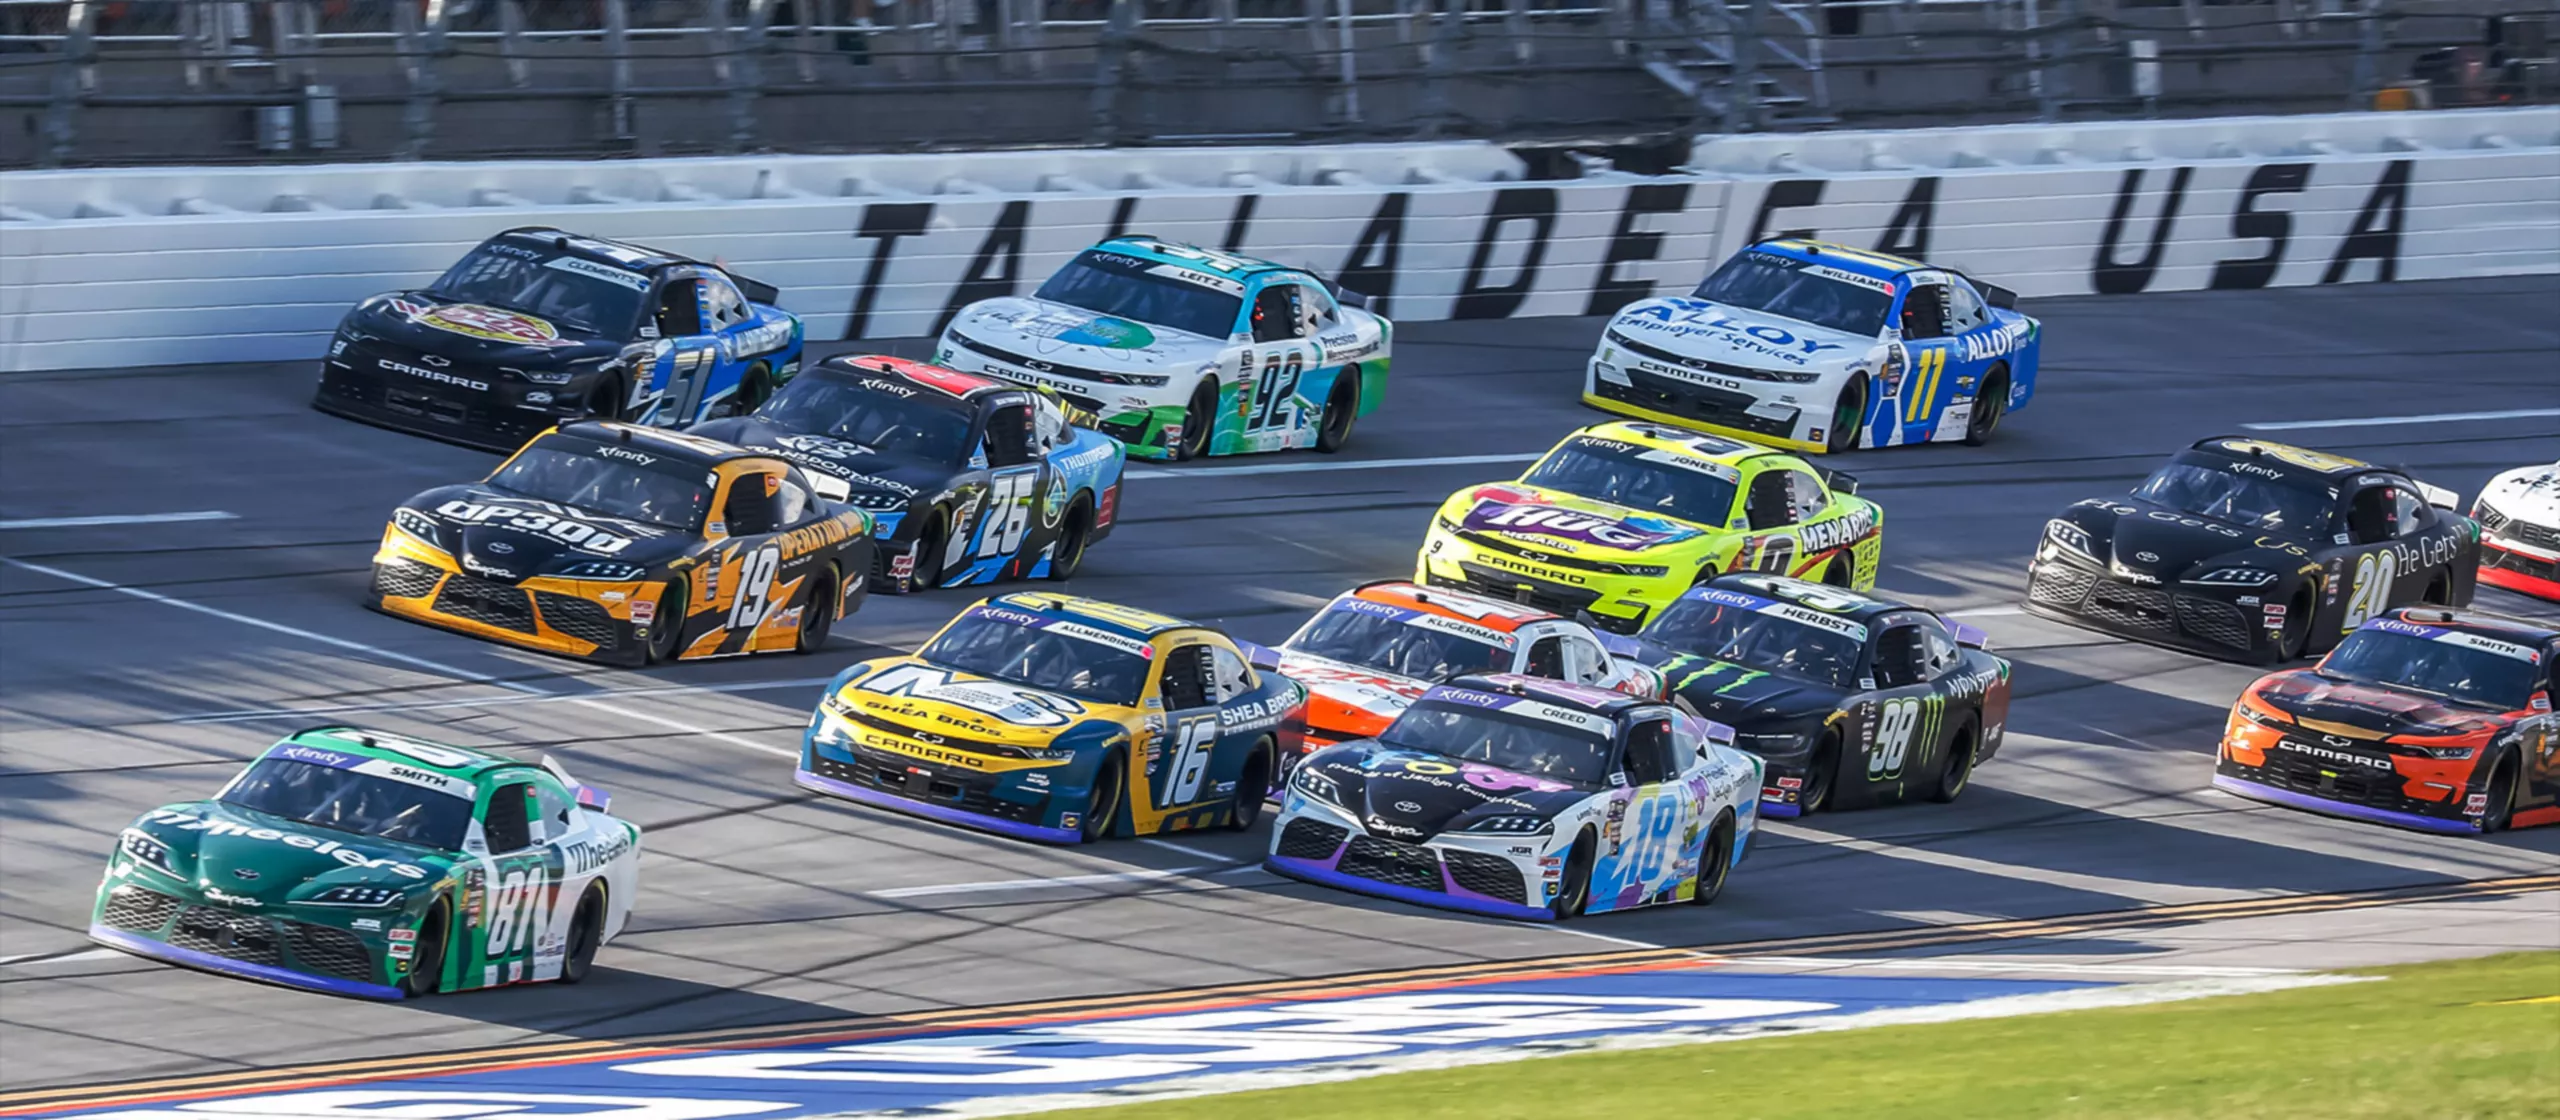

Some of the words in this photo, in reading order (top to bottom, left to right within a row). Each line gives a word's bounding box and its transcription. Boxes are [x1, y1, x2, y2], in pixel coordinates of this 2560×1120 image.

[2093, 160, 2414, 293] USA
[488, 244, 543, 260] xfinity
[1091, 253, 1144, 268] xfinity
[1747, 252, 1797, 268] xfinity
[1179, 270, 1225, 287] LEITZ
[1822, 268, 1885, 289] WILLIAMS
[1616, 315, 1720, 338] Employer
[1720, 331, 1809, 366] Services
[1628, 306, 1845, 354] ALLOY
[1966, 328, 2014, 362] ALLOY
[378, 358, 489, 392] CAMARO
[655, 347, 715, 426] 51
[859, 377, 918, 399] xfinity
[983, 364, 1088, 394] CAMARO
[1640, 361, 1740, 389] CAMARO
[1906, 348, 1946, 422] 11
[1246, 349, 1304, 433] 92
[597, 445, 657, 466] xfinity
[1578, 437, 1634, 453] xfinity
[744, 445, 919, 498] TRANSPORTATION
[1670, 455, 1718, 473] JONES
[2229, 462, 2284, 480] xfinity
[436, 500, 633, 553] OP300
[979, 473, 1036, 557] 26
[2148, 510, 2243, 537] Gets
[1499, 530, 1578, 553] MENARDS
[1800, 506, 1873, 553] MENARDS
[1430, 540, 1443, 554] 9
[2396, 543, 2420, 577] He
[2420, 535, 2458, 567] Gets
[463, 553, 517, 578] Supra
[1476, 553, 1586, 585] CAMARO
[727, 547, 780, 629] 19
[1699, 591, 1755, 607] xfinity
[2342, 551, 2396, 635] 20
[978, 607, 1040, 625] xfinity
[1345, 600, 1405, 618] xfinity
[1783, 607, 1854, 633] HERBST
[1061, 624, 1145, 650] ALLMENDINGE
[1427, 617, 1506, 643] KLIGERMAN
[2375, 619, 2431, 636] xfinity
[2468, 637, 2517, 654] SMITH
[865, 700, 928, 718] SHEA
[1221, 702, 1265, 726] SHEA
[1265, 688, 1297, 713] BROS
[1439, 689, 1499, 706] xfinity
[1542, 707, 1586, 724] CREED
[865, 734, 984, 767] CAMARO
[1867, 698, 1919, 781] 98
[283, 747, 348, 765] xfinity
[1161, 721, 1217, 806] 16
[2278, 740, 2392, 770] CAMARO
[389, 766, 448, 787] SMITH
[1402, 771, 1453, 787] Jaclyn
[1367, 814, 1423, 836] Supra
[1507, 846, 1532, 855] JGR
[1625, 795, 1678, 885] 18
[487, 866, 543, 956] 81
